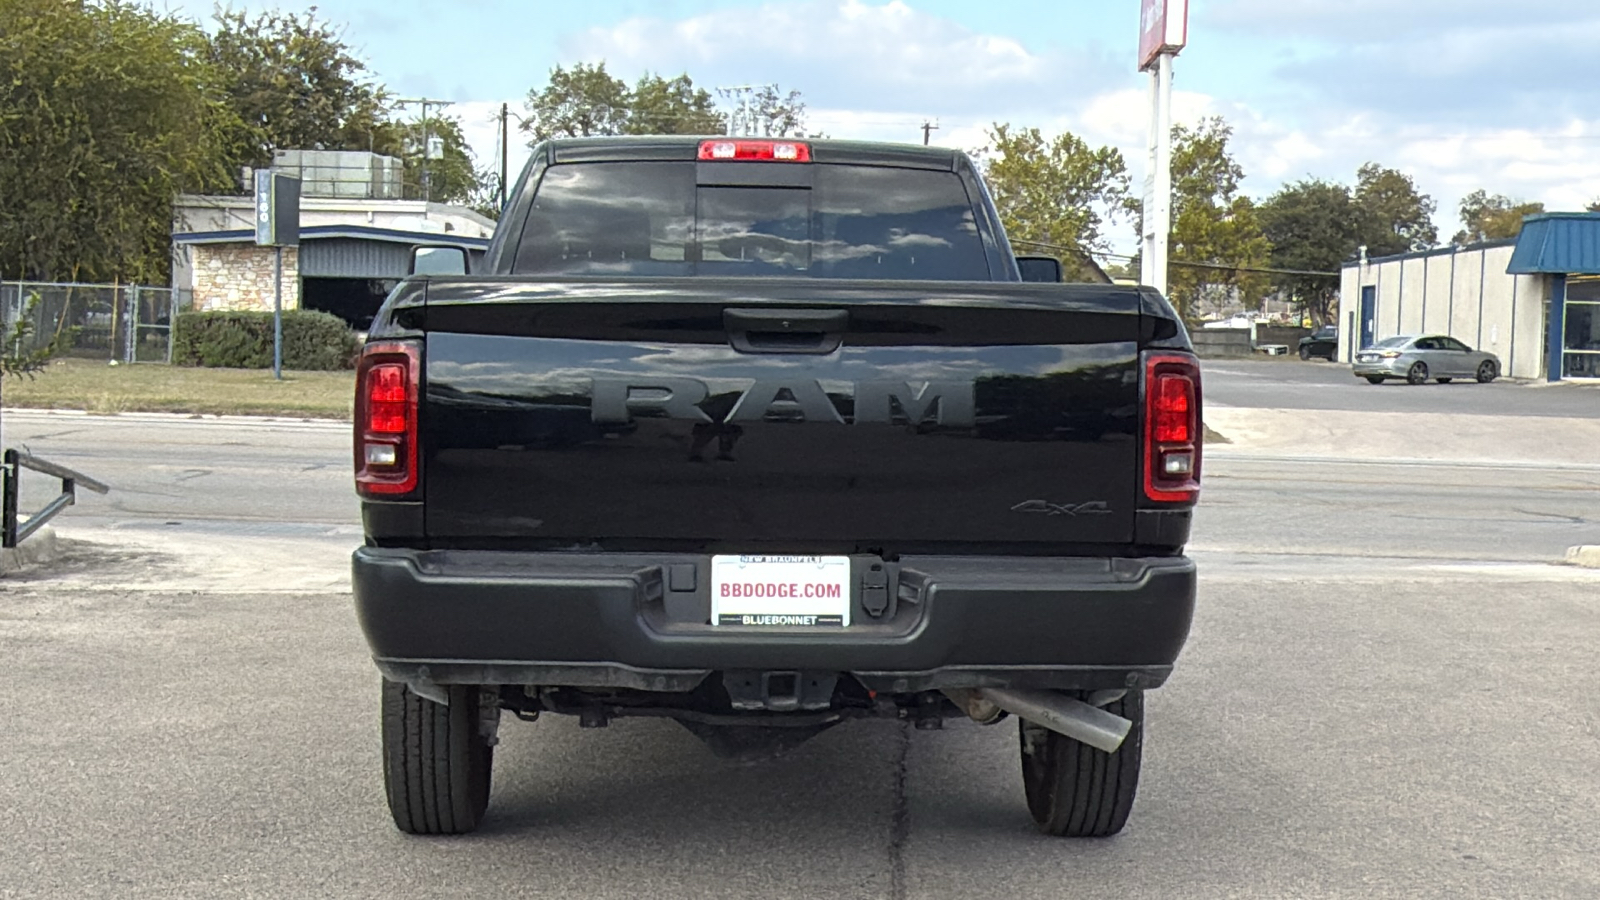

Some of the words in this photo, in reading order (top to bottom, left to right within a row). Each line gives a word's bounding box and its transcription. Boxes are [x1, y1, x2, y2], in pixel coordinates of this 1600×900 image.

[591, 378, 975, 425] RAM
[720, 583, 841, 598] BBDODGE.COM
[742, 615, 818, 625] BLUEBONNET
